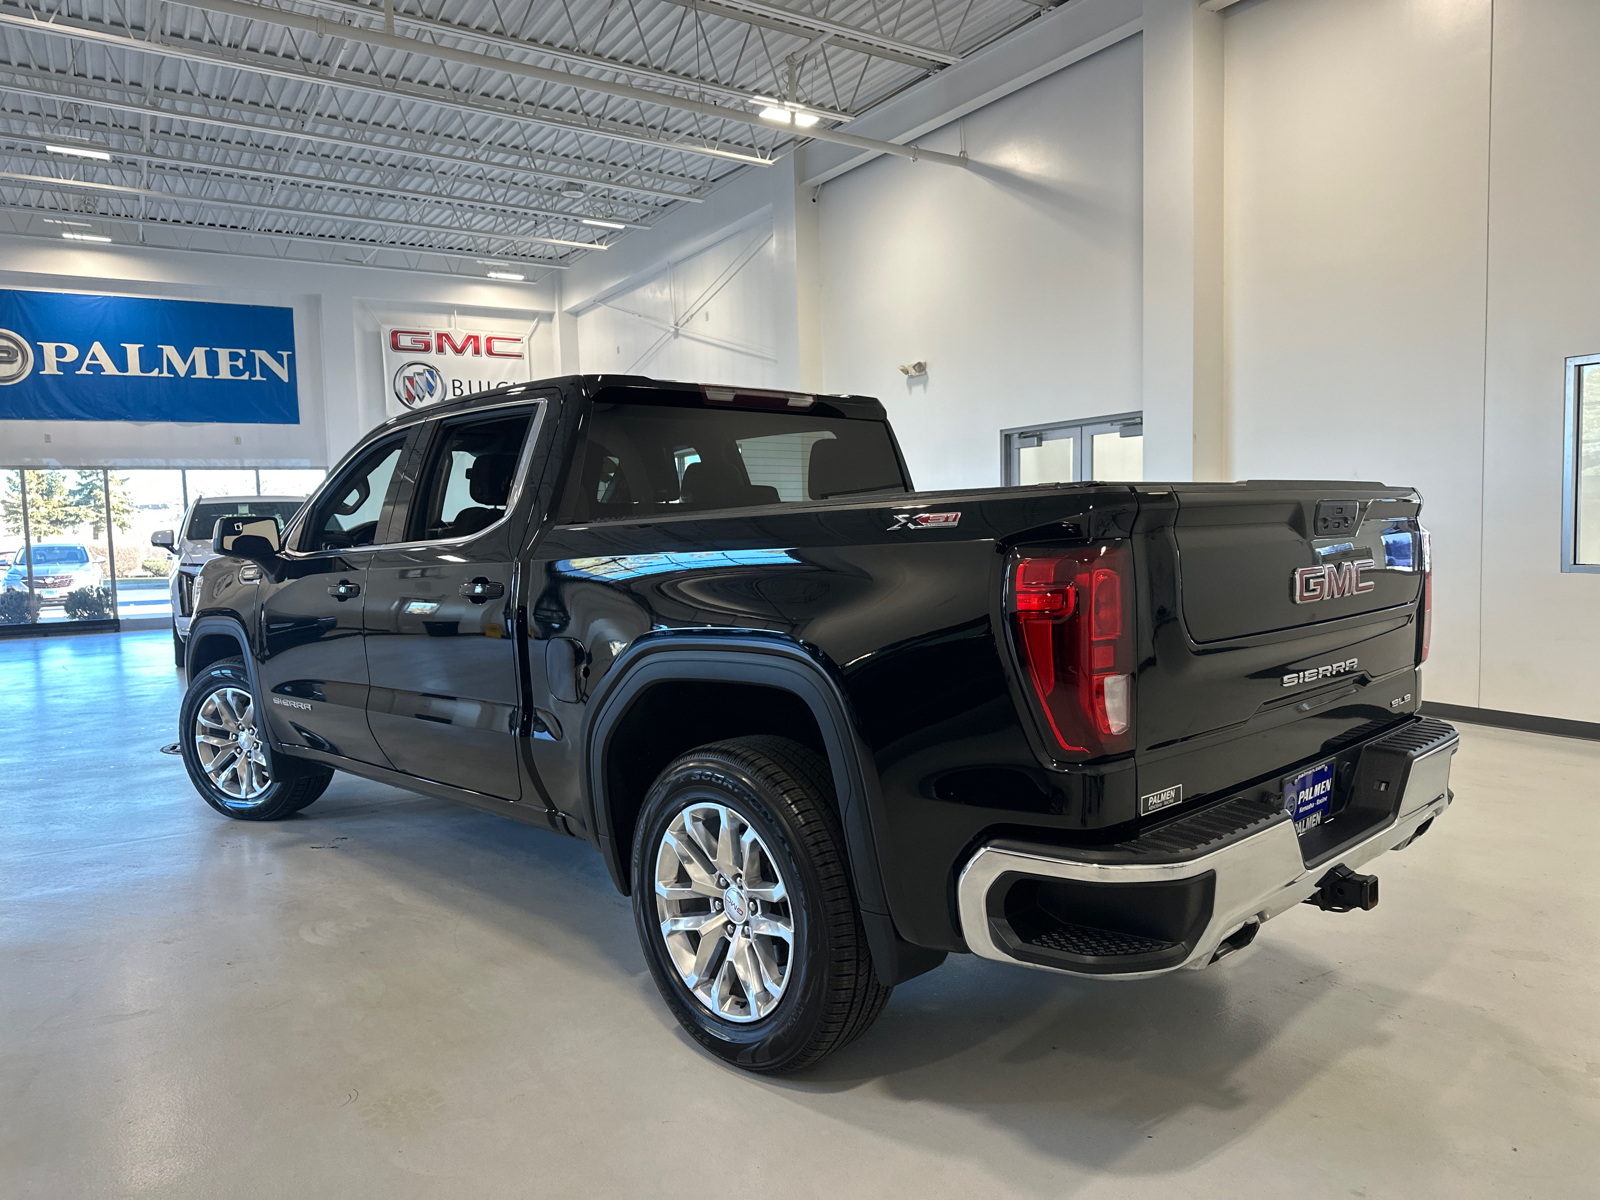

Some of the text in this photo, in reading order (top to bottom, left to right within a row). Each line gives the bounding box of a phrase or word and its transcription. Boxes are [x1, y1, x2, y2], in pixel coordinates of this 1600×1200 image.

[389, 328, 524, 360] GMC
[36, 341, 293, 383] PALMEN
[452, 379, 516, 397] BUI
[1292, 558, 1375, 604] GMC
[1282, 657, 1358, 687] SIERRA
[273, 697, 312, 710] SIERRA
[1148, 788, 1176, 807] PALMEN
[1298, 778, 1332, 804] PALMEN
